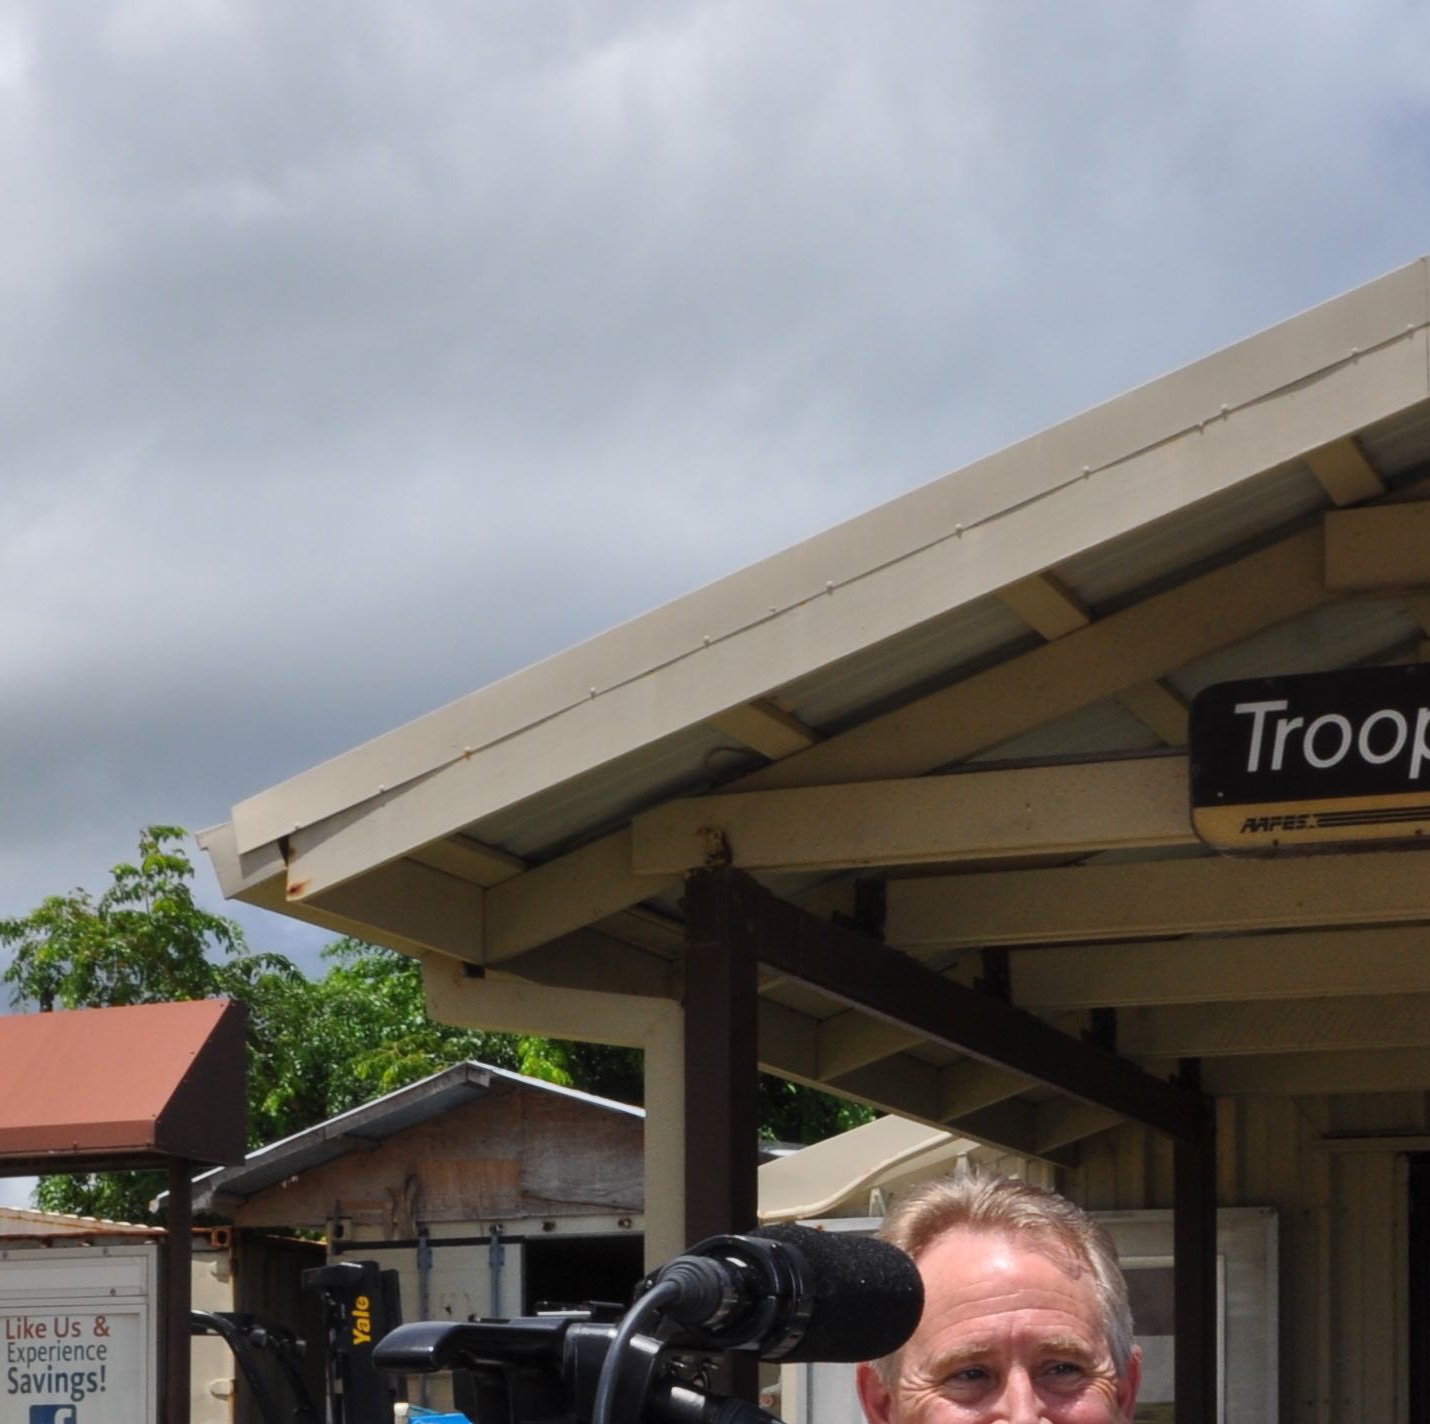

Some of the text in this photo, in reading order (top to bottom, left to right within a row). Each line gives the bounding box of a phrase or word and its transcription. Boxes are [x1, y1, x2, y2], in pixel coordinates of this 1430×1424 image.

[1240, 813, 1310, 834] AAFES
[5, 1314, 111, 1340] Like Us &
[352, 1295, 371, 1346] Yale
[7, 1340, 108, 1369] Experience
[7, 1364, 107, 1402] Savings!
